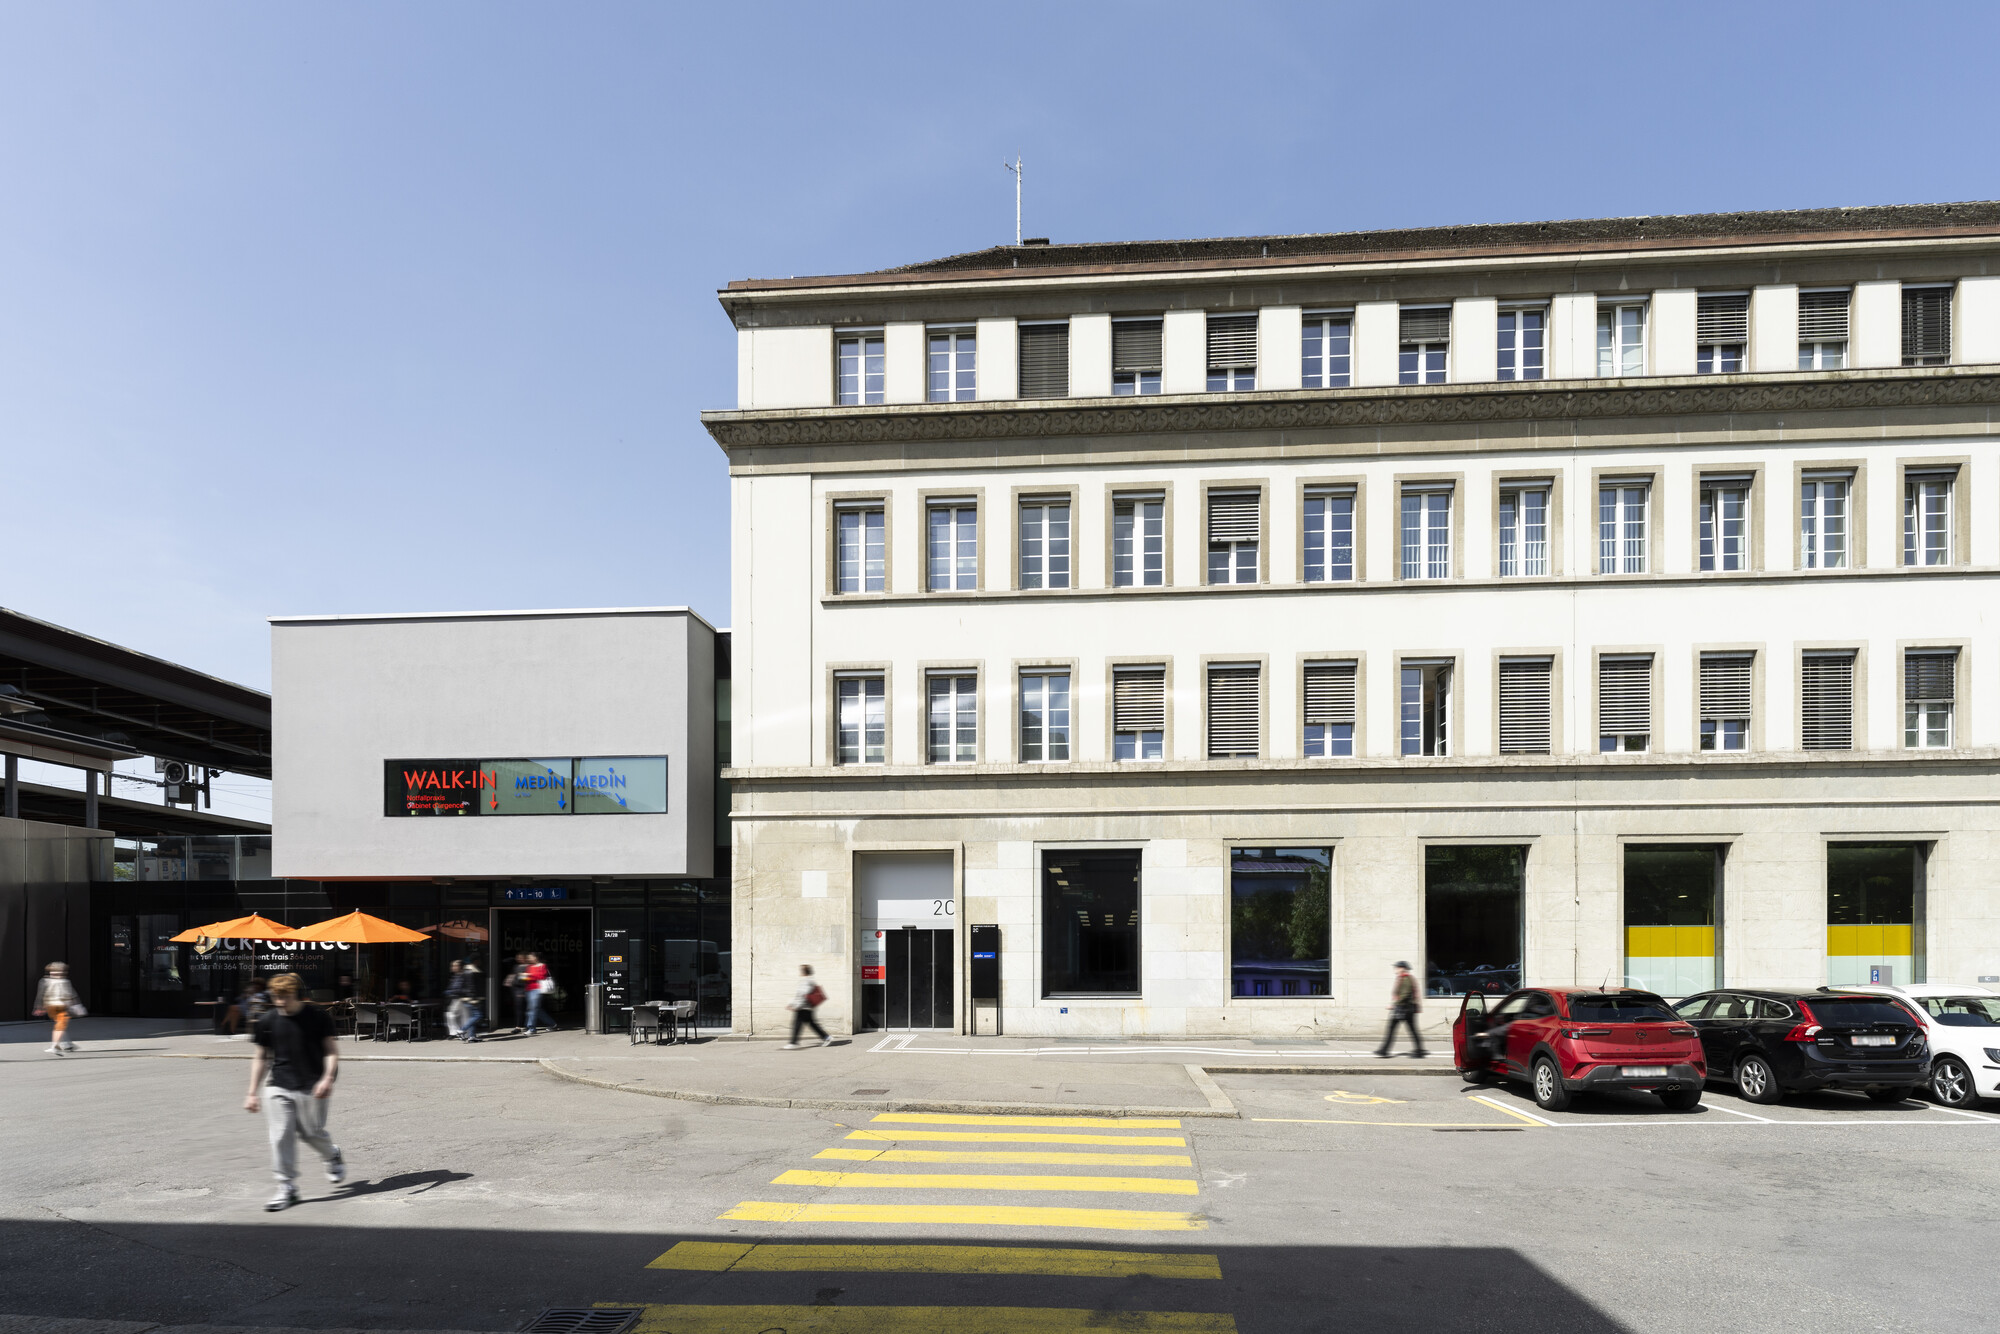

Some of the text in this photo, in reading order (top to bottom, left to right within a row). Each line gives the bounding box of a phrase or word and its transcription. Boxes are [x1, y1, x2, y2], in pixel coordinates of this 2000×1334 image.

[403, 769, 496, 790] WALK-IN
[406, 794, 446, 802] Notfallpraxis
[432, 802, 465, 810] d'urgence
[271, 953, 289, 961] frais
[223, 963, 237, 971] 364
[238, 963, 257, 973] Tage
[259, 962, 294, 971] natürlich
